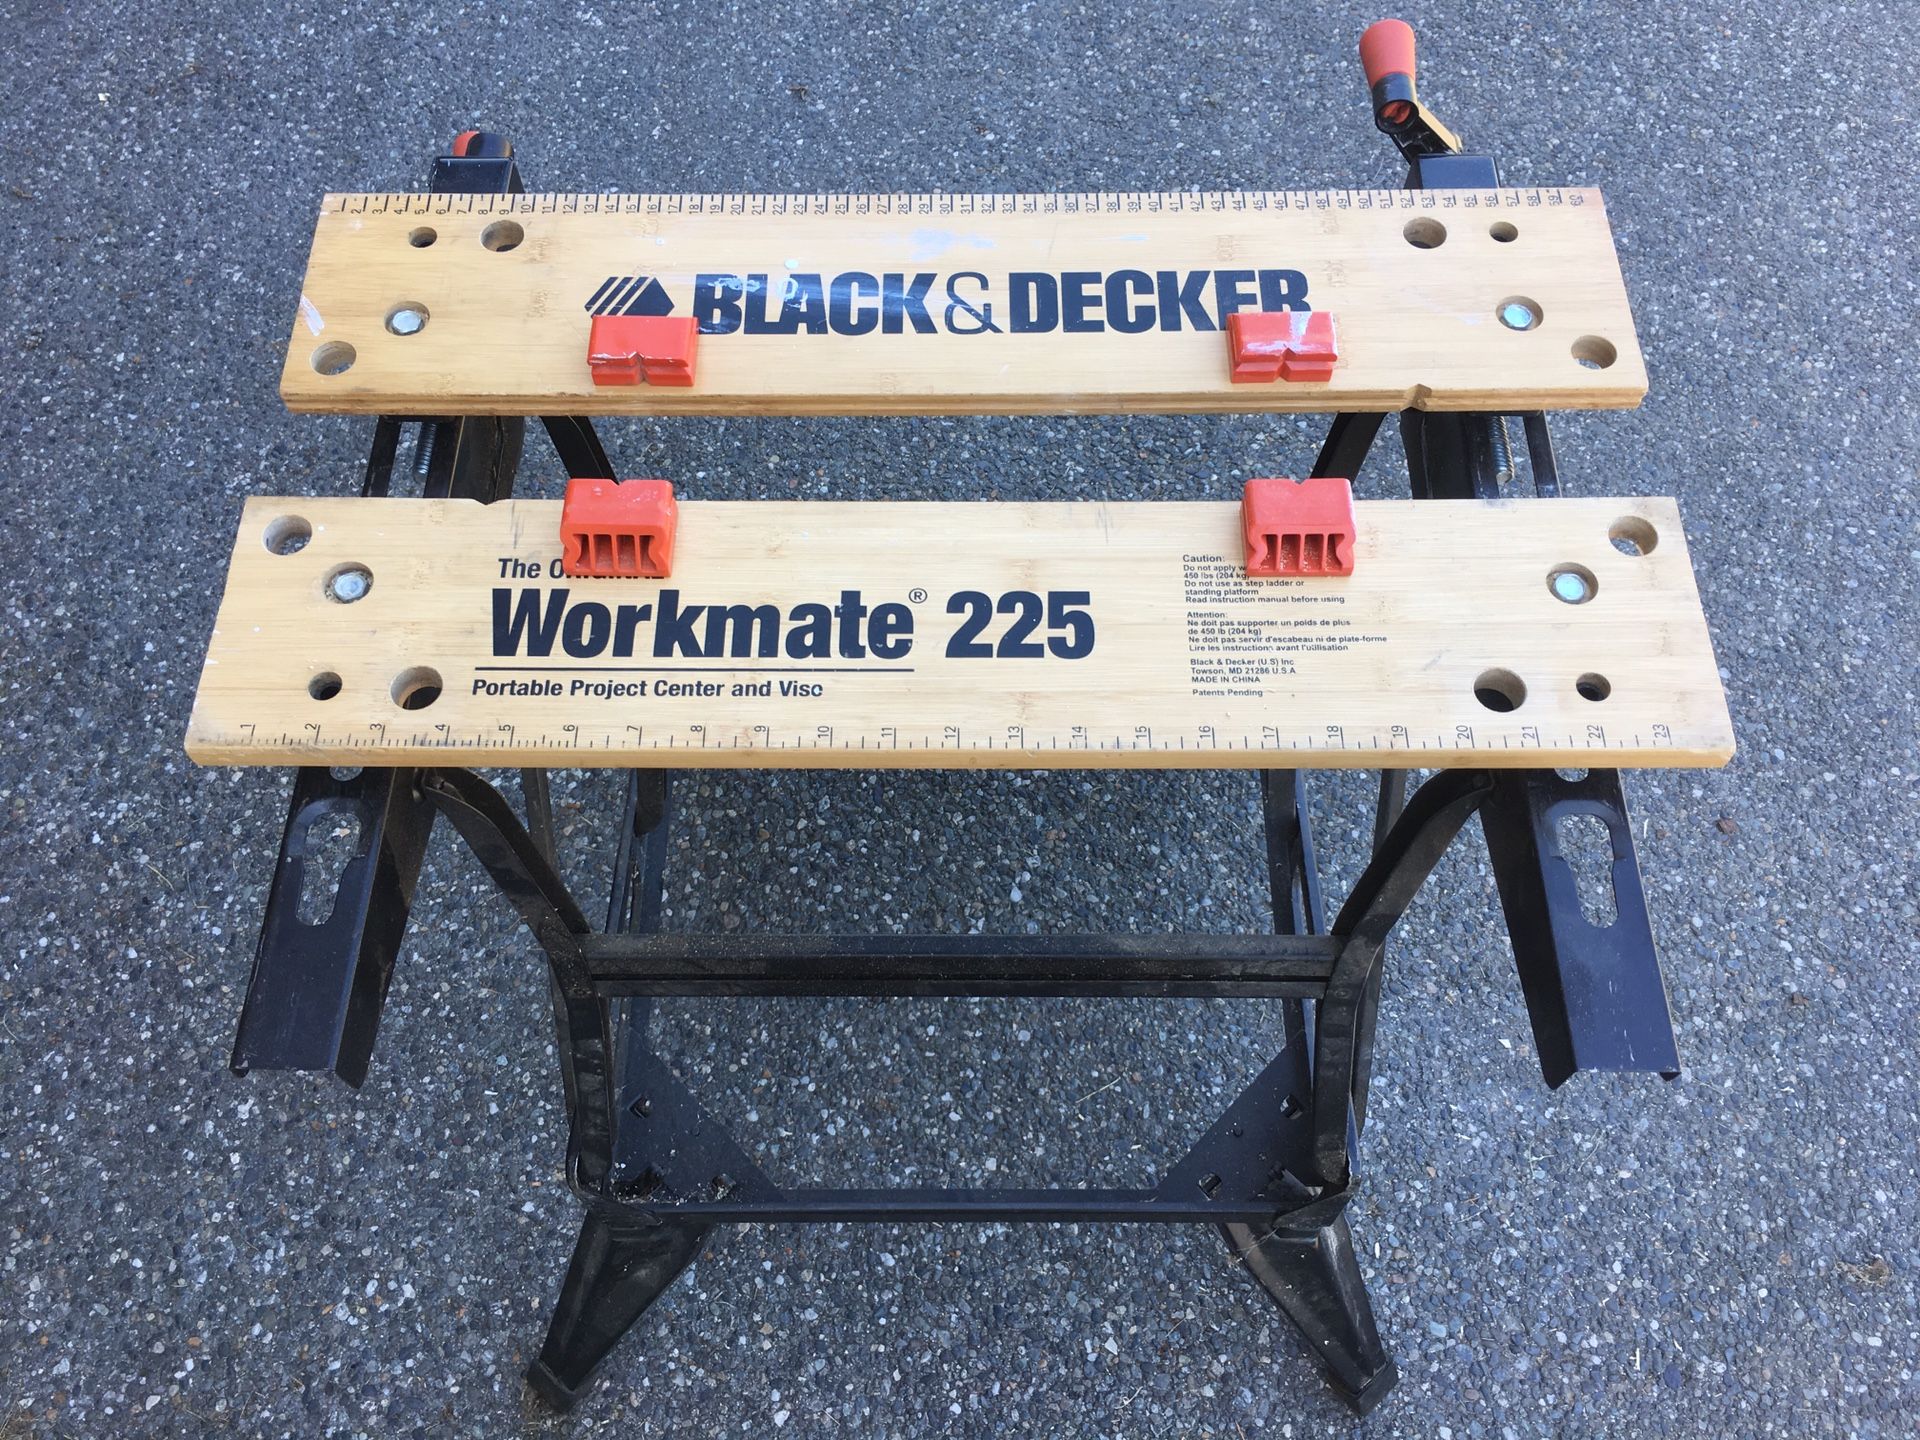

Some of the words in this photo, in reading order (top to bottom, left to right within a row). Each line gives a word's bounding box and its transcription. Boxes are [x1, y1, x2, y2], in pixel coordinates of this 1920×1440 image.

[521, 204, 531, 214] 10
[542, 205, 552, 214] 11
[563, 204, 573, 214] 12
[584, 204, 594, 214] 13
[605, 204, 615, 214] 14
[626, 204, 636, 214] 15
[648, 204, 657, 214] 16
[668, 204, 678, 214] 17
[689, 204, 699, 214] 18
[710, 204, 720, 214] 19
[731, 204, 741, 215] 20
[752, 204, 762, 215] 21
[772, 204, 782, 215] 22
[794, 204, 803, 215] 23
[814, 204, 824, 215] 24
[835, 204, 845, 215] 25
[856, 204, 866, 214] 26
[877, 204, 887, 214] 27
[898, 203, 908, 214] 28
[919, 203, 929, 214] 29
[940, 203, 950, 214] 30
[961, 203, 971, 214] 31
[982, 203, 991, 214] 32
[1003, 203, 1012, 214] 33
[1045, 203, 1054, 214] 35
[1066, 202, 1075, 213] 36
[1086, 202, 1096, 213] 37
[1107, 202, 1117, 212] 38
[1128, 202, 1138, 212] 39
[1150, 202, 1159, 212] 40
[1170, 201, 1179, 212] 41
[1191, 201, 1200, 212] 42
[1211, 200, 1222, 211] 43
[1233, 200, 1242, 211] 44
[1254, 200, 1263, 211] 45
[1274, 199, 1284, 210] 46
[1296, 200, 1305, 210] 47
[1317, 198, 1326, 209] 48
[1338, 198, 1347, 209] 49
[1182, 554, 1225, 563] Caution:
[498, 558, 542, 578] The
[1213, 564, 1236, 573] apply
[1216, 572, 1234, 580] (204
[1185, 588, 1221, 596] standing
[1224, 588, 1259, 596] platform
[1321, 596, 1345, 604] using
[945, 589, 1096, 660] 225
[1228, 628, 1246, 636] (204
[1248, 628, 1262, 636] kg)
[1339, 635, 1387, 644] plate-forme
[472, 679, 563, 698] Portable
[570, 679, 648, 700] Project
[654, 679, 726, 698] Center
[731, 680, 772, 698] and
[1227, 689, 1263, 697] Pending
[818, 725, 830, 739] 10
[881, 727, 893, 738] 11
[944, 726, 956, 739] 12
[1008, 726, 1020, 740] 13
[1072, 726, 1083, 739] 14
[1136, 726, 1147, 739] 15
[1200, 726, 1211, 740] 16
[1263, 726, 1274, 740] 17
[1328, 725, 1339, 739] 18
[1392, 725, 1404, 738] 19
[1456, 724, 1470, 740] 20
[1522, 725, 1535, 739] 21
[1588, 724, 1601, 739] 22
[1654, 724, 1665, 738] 23
